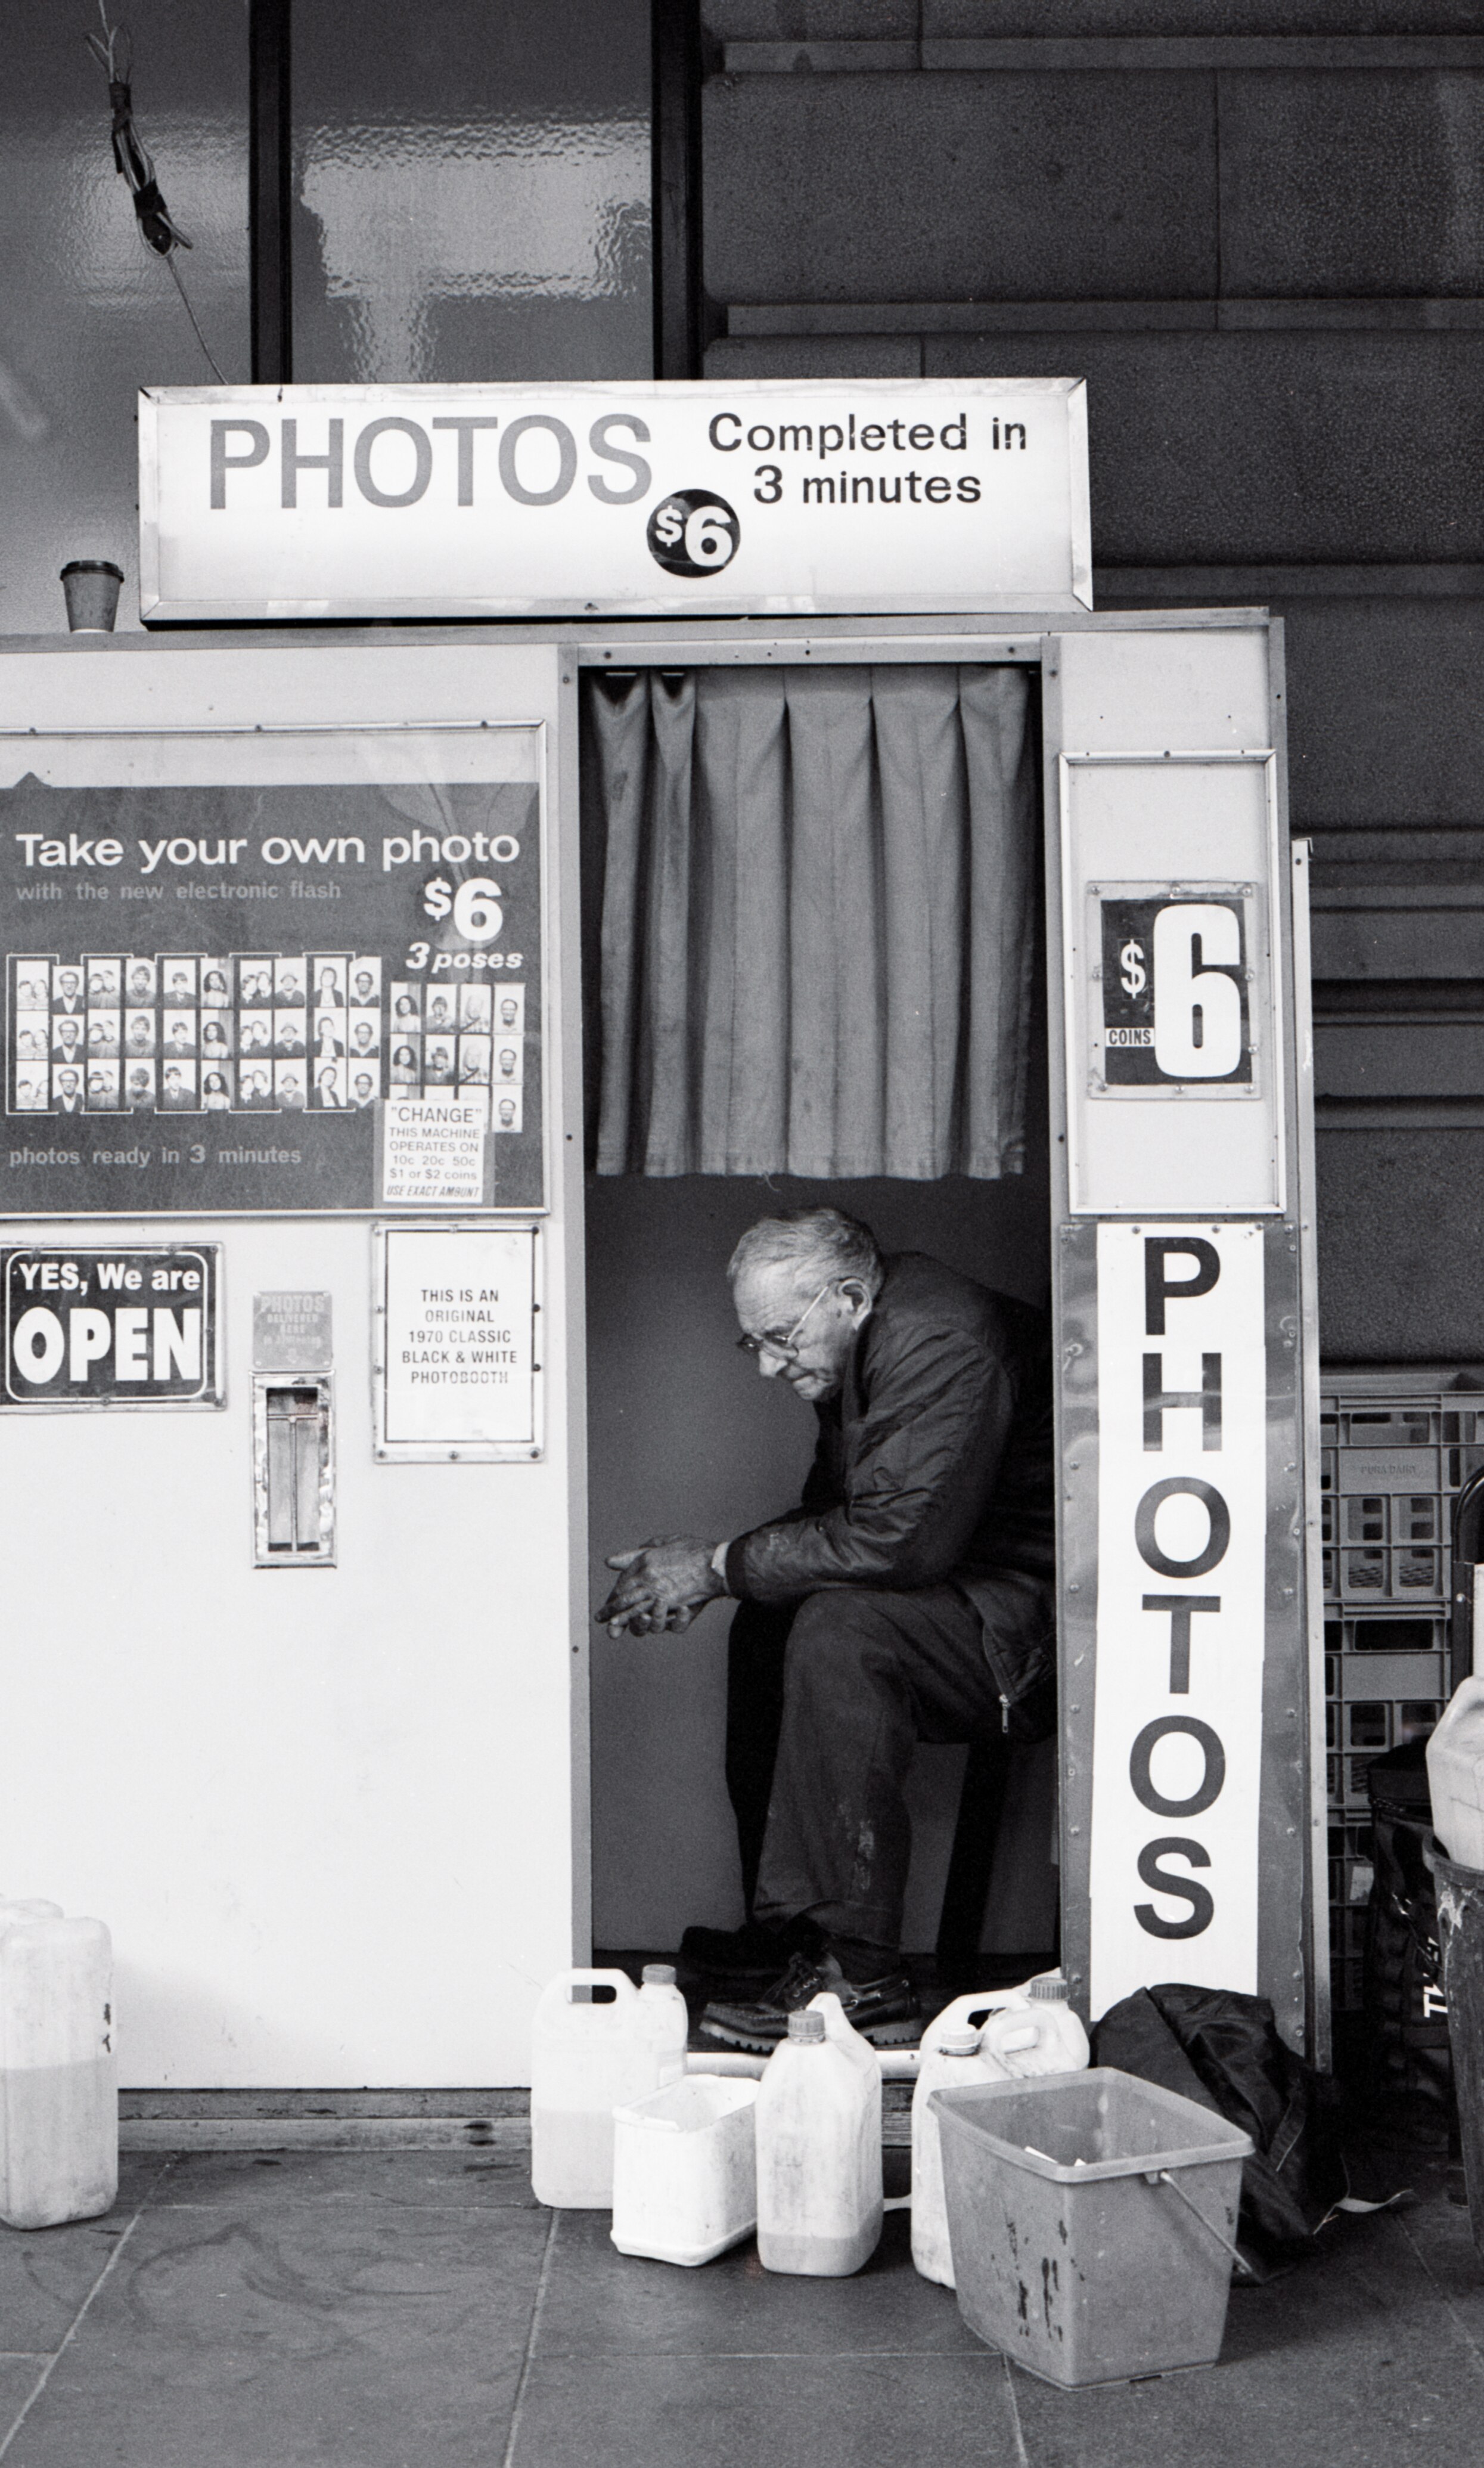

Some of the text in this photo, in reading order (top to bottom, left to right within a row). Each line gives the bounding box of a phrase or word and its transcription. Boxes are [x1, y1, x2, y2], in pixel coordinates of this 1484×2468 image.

[210, 413, 1026, 510] PHOTOS Completed in
[753, 464, 982, 504] 3 minutes
[654, 505, 733, 568] $6
[15, 829, 520, 874] Take your own photo
[16, 880, 341, 900] with the new electronic flash
[423, 877, 504, 941] $6
[405, 941, 524, 973] 3 poses
[1109, 1030, 1151, 1045] COINS
[391, 1105, 482, 1123] "CHANGE"
[389, 1128, 480, 1139] THIS MACHINE
[390, 1142, 479, 1152] OPERATES ON
[10, 1145, 302, 1168] photos ready in 3 minutes
[393, 1155, 476, 1166] 10c 20c 50c
[390, 1168, 403, 1179] $1
[425, 1169, 440, 1179] $2
[444, 1170, 477, 1180] coins
[387, 1185, 405, 1196] USE
[407, 1185, 438, 1196] EXACT
[19, 1263, 200, 1295] YES, We are
[261, 1295, 324, 1312] PHOTOS
[421, 1290, 499, 1302] THIS IS AN
[425, 1310, 494, 1322] ORIGINAL
[409, 1331, 511, 1342] 1970 CLASSIC
[13, 1307, 201, 1384] OPEN
[402, 1351, 517, 1363] BLACK & WHITE
[411, 1372, 508, 1384] PHOTOBOOTH
[1128, 1236, 1231, 1940] PHOTOS
